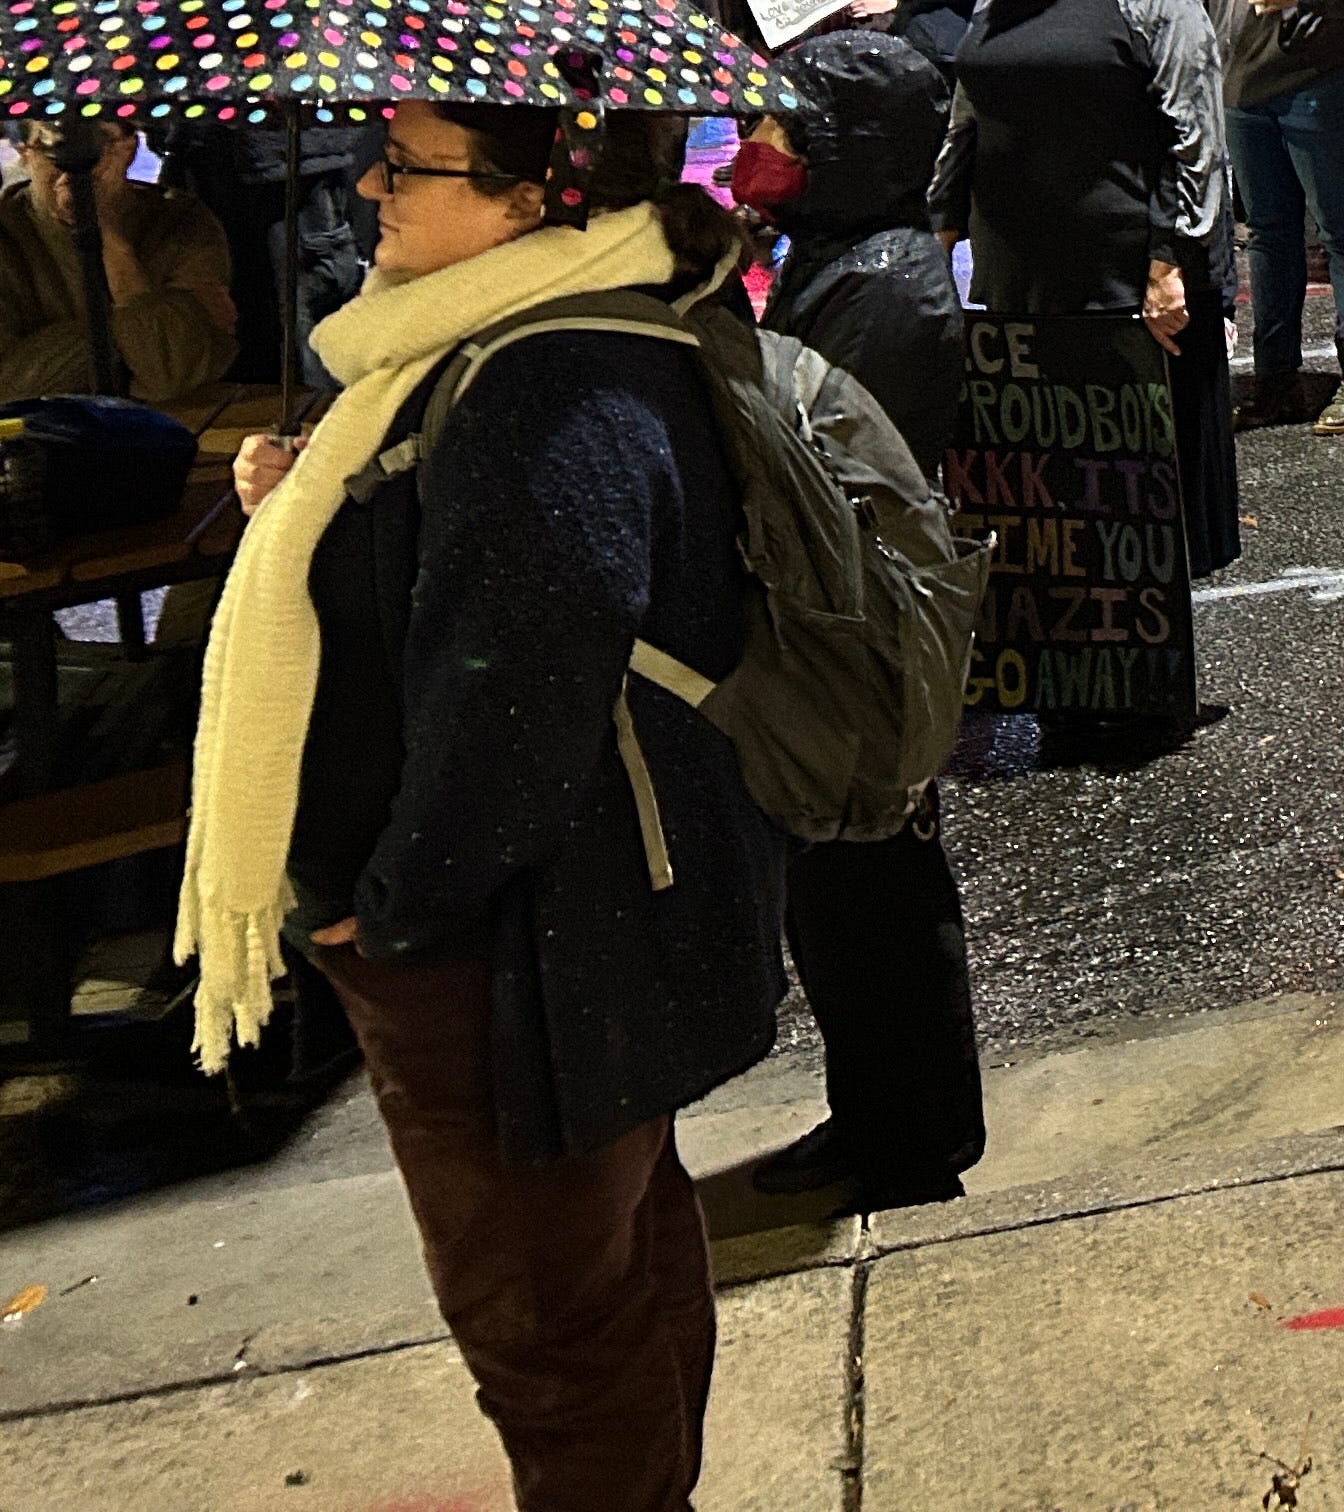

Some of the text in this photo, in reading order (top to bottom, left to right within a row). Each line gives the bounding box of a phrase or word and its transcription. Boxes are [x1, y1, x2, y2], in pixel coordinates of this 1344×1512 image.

[959, 379, 1175, 457] ROUDBOYS
[1073, 456, 1178, 521] ITS
[1095, 519, 1175, 585] YOU
